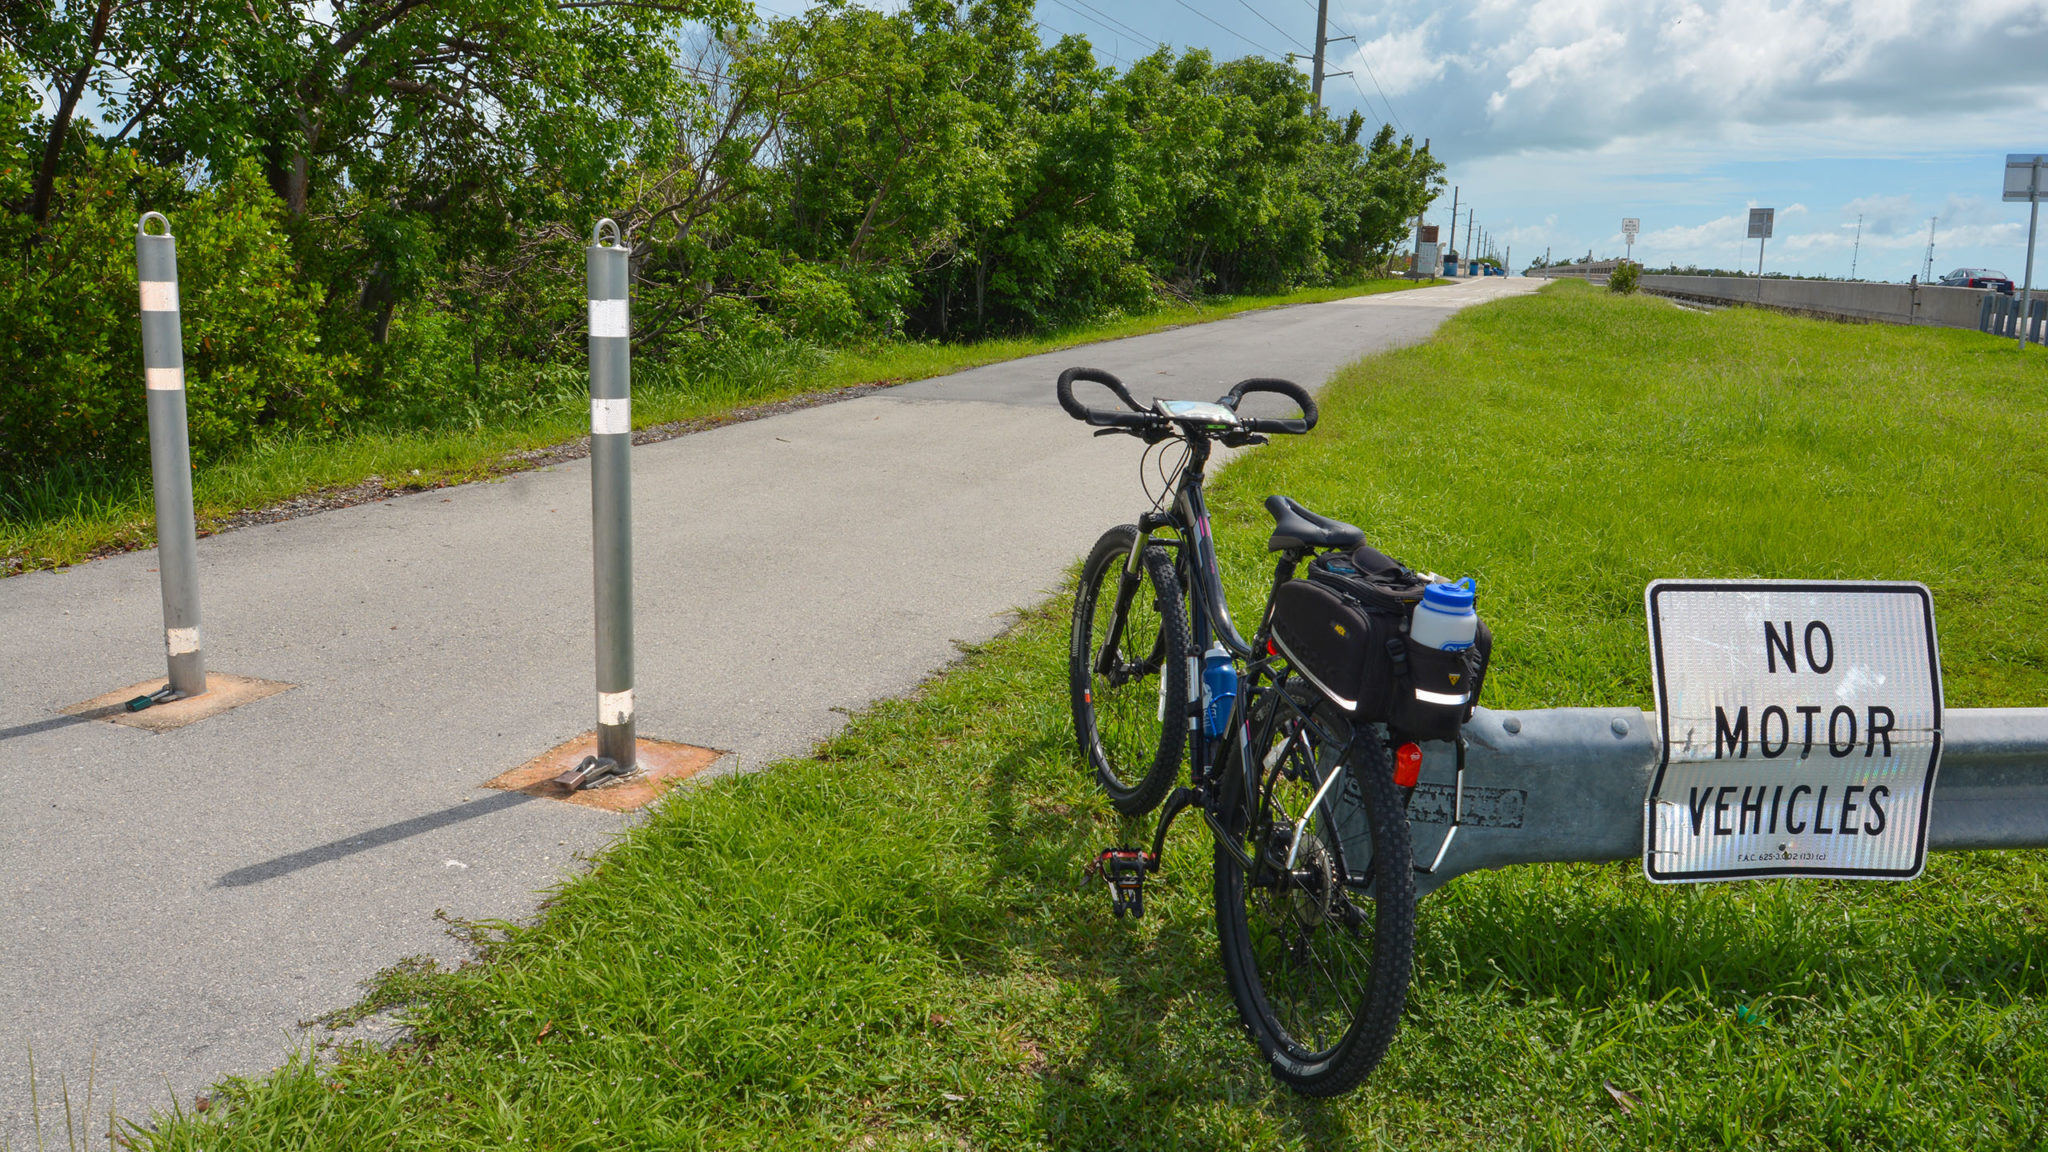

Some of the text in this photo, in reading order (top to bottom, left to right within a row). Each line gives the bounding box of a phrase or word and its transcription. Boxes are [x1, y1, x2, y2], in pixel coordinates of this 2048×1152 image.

[1764, 620, 1834, 675] NO
[1715, 705, 1895, 760] MOTOR
[1689, 785, 1890, 836] VEHICLES
